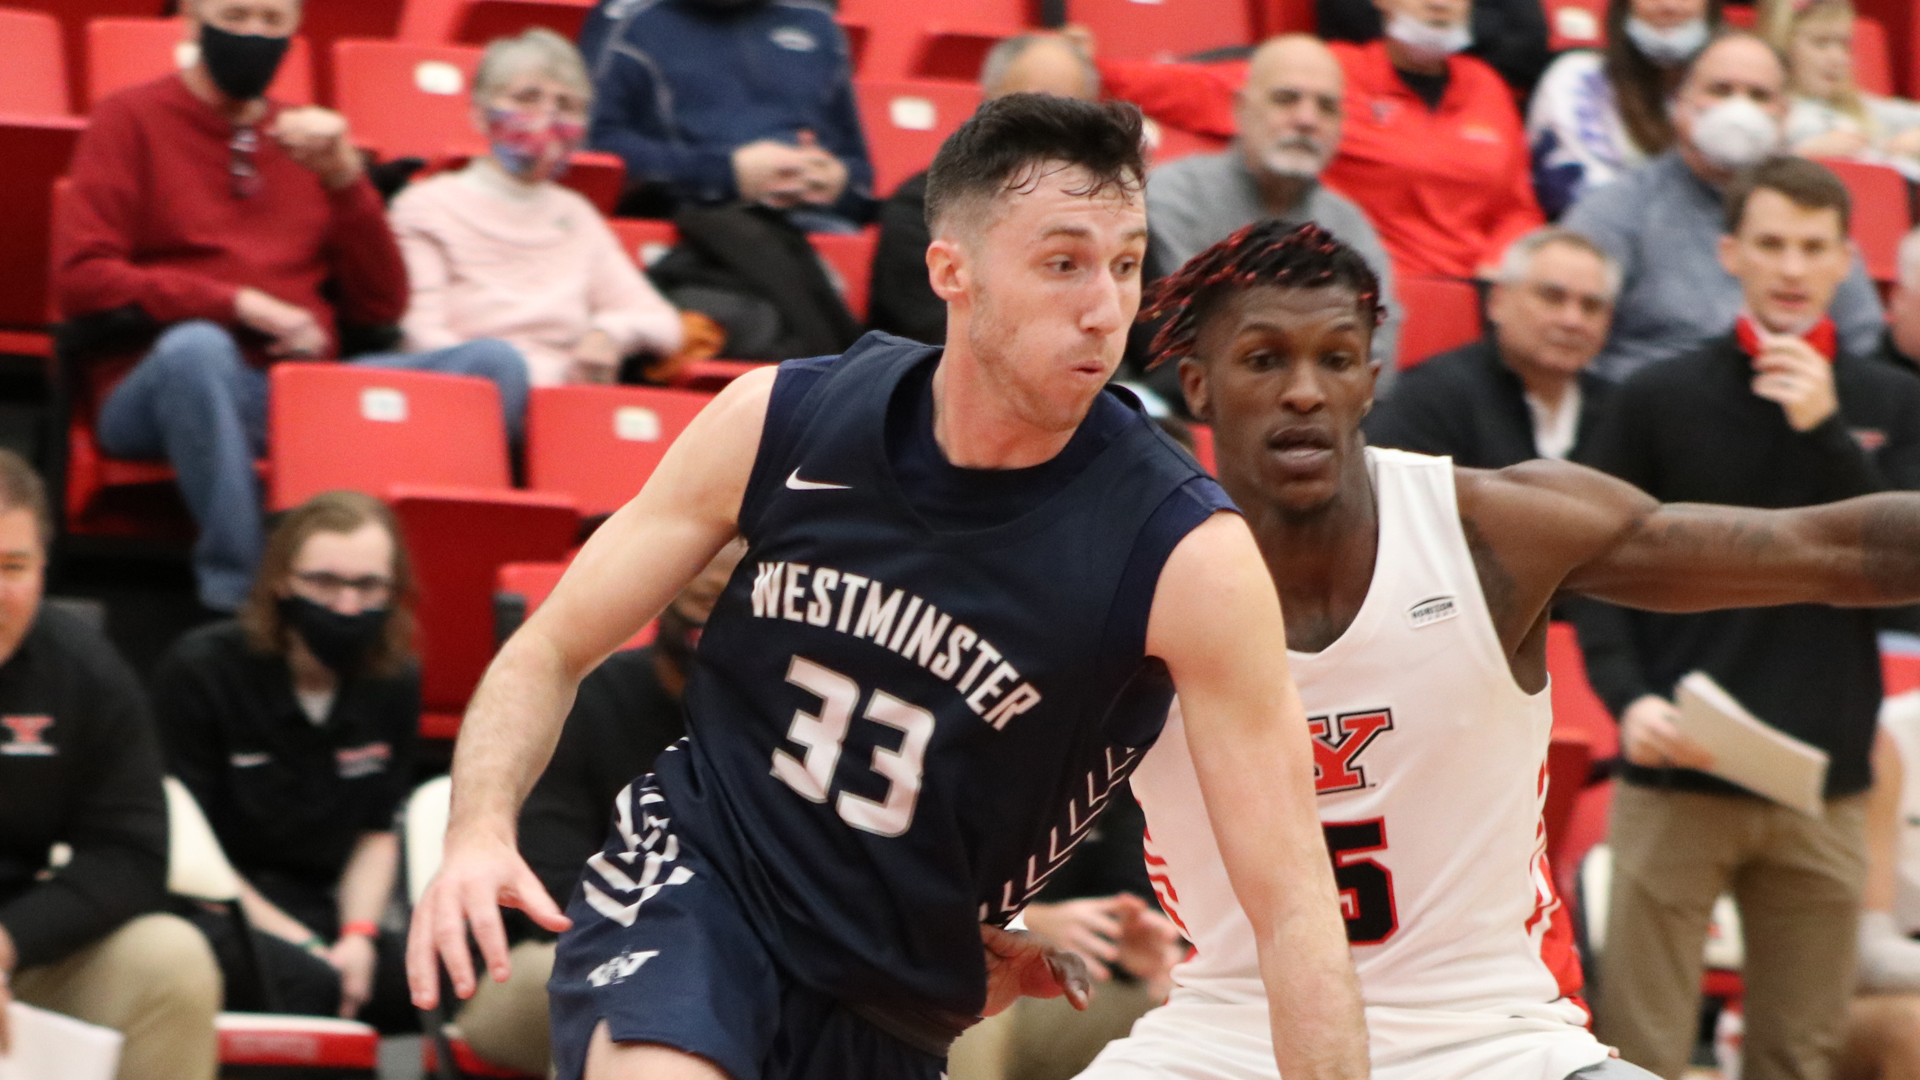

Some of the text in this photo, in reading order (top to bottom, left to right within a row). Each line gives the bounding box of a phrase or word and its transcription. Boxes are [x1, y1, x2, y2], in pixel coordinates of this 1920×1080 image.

[752, 561, 1042, 731] WESTMINSTER
[769, 654, 935, 838] 33
[1307, 707, 1394, 795] Y
